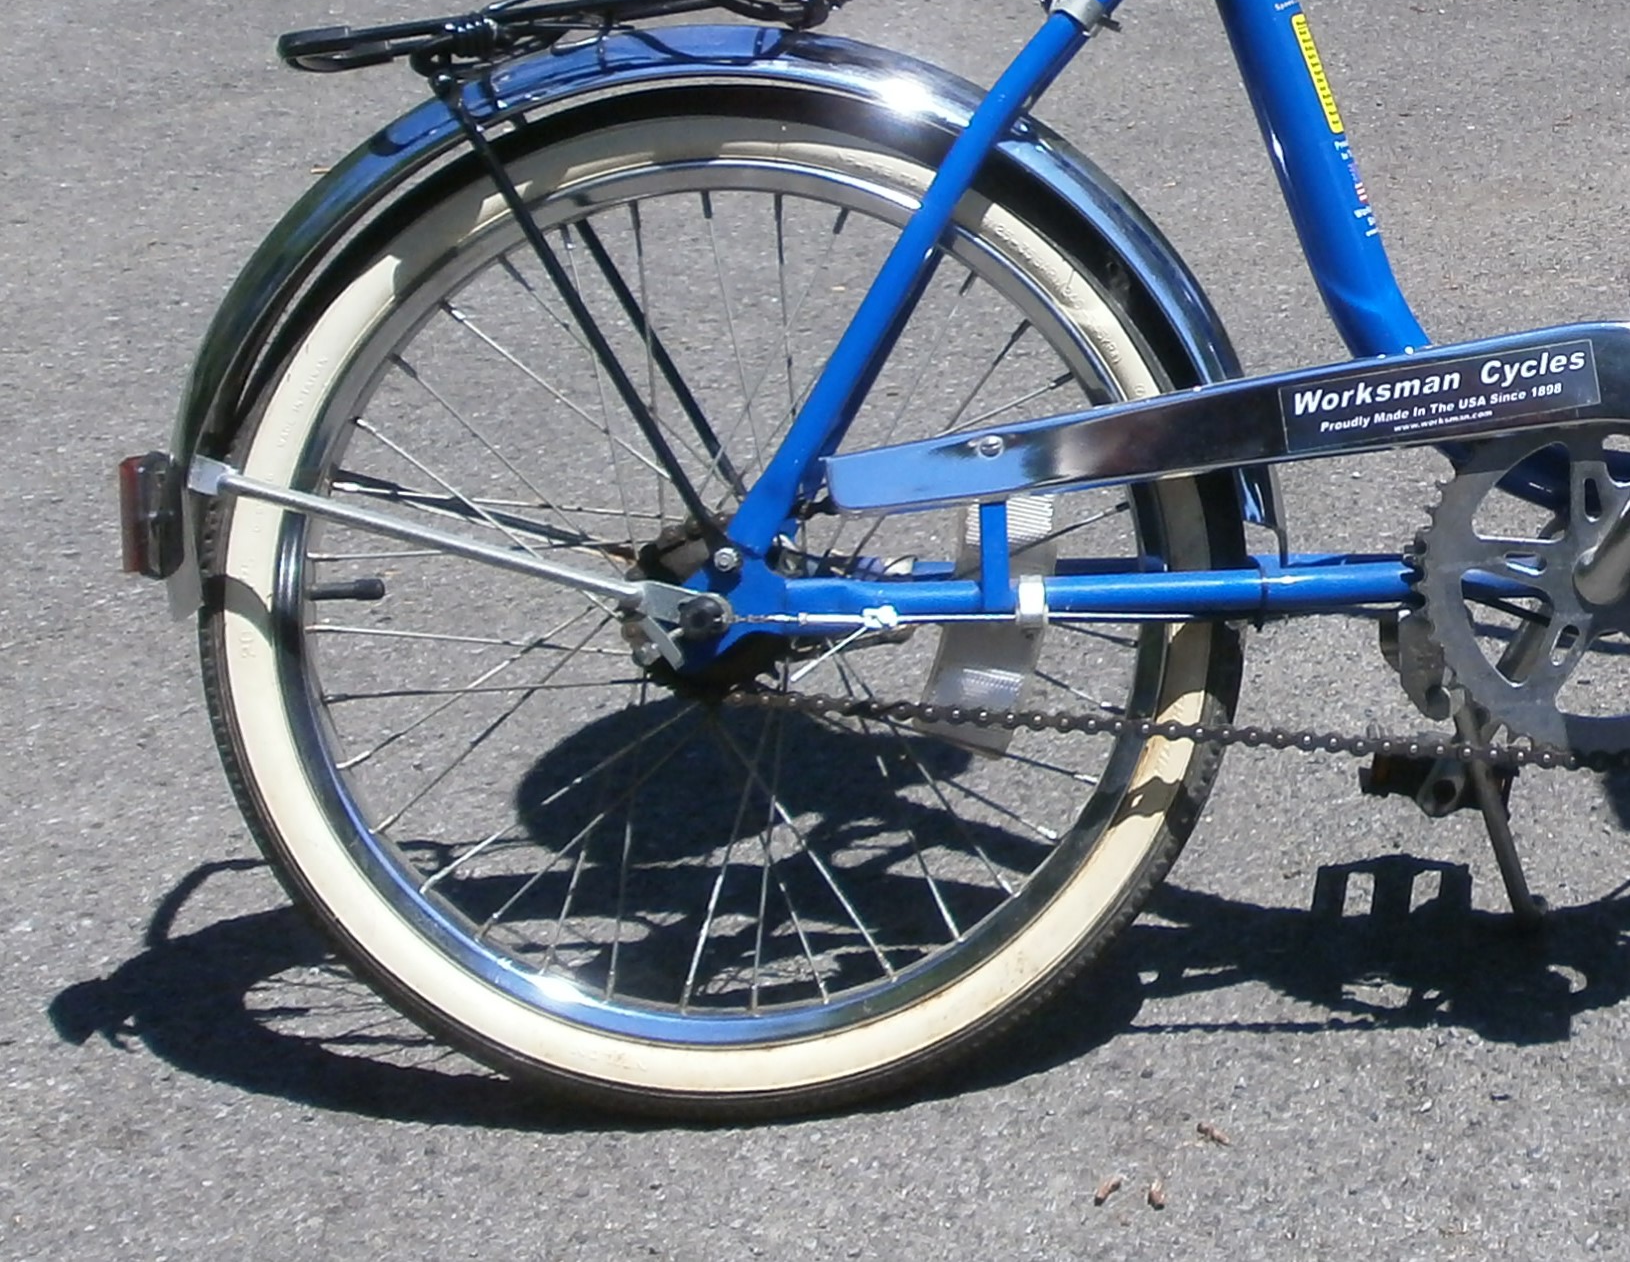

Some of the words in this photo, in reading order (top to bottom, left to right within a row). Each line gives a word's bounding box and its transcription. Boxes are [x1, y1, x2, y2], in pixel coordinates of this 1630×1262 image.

[1294, 371, 1461, 416] Worksman
[1480, 351, 1586, 388] Cycles
[1320, 416, 1371, 433] Proudly
[1374, 409, 1409, 425] Made
[1413, 406, 1426, 417] In
[1430, 402, 1455, 415] The
[1458, 395, 1487, 410] USA
[1489, 390, 1527, 405] Since
[1531, 382, 1563, 398] 1898
[1393, 409, 1493, 433] www.worksman.com
